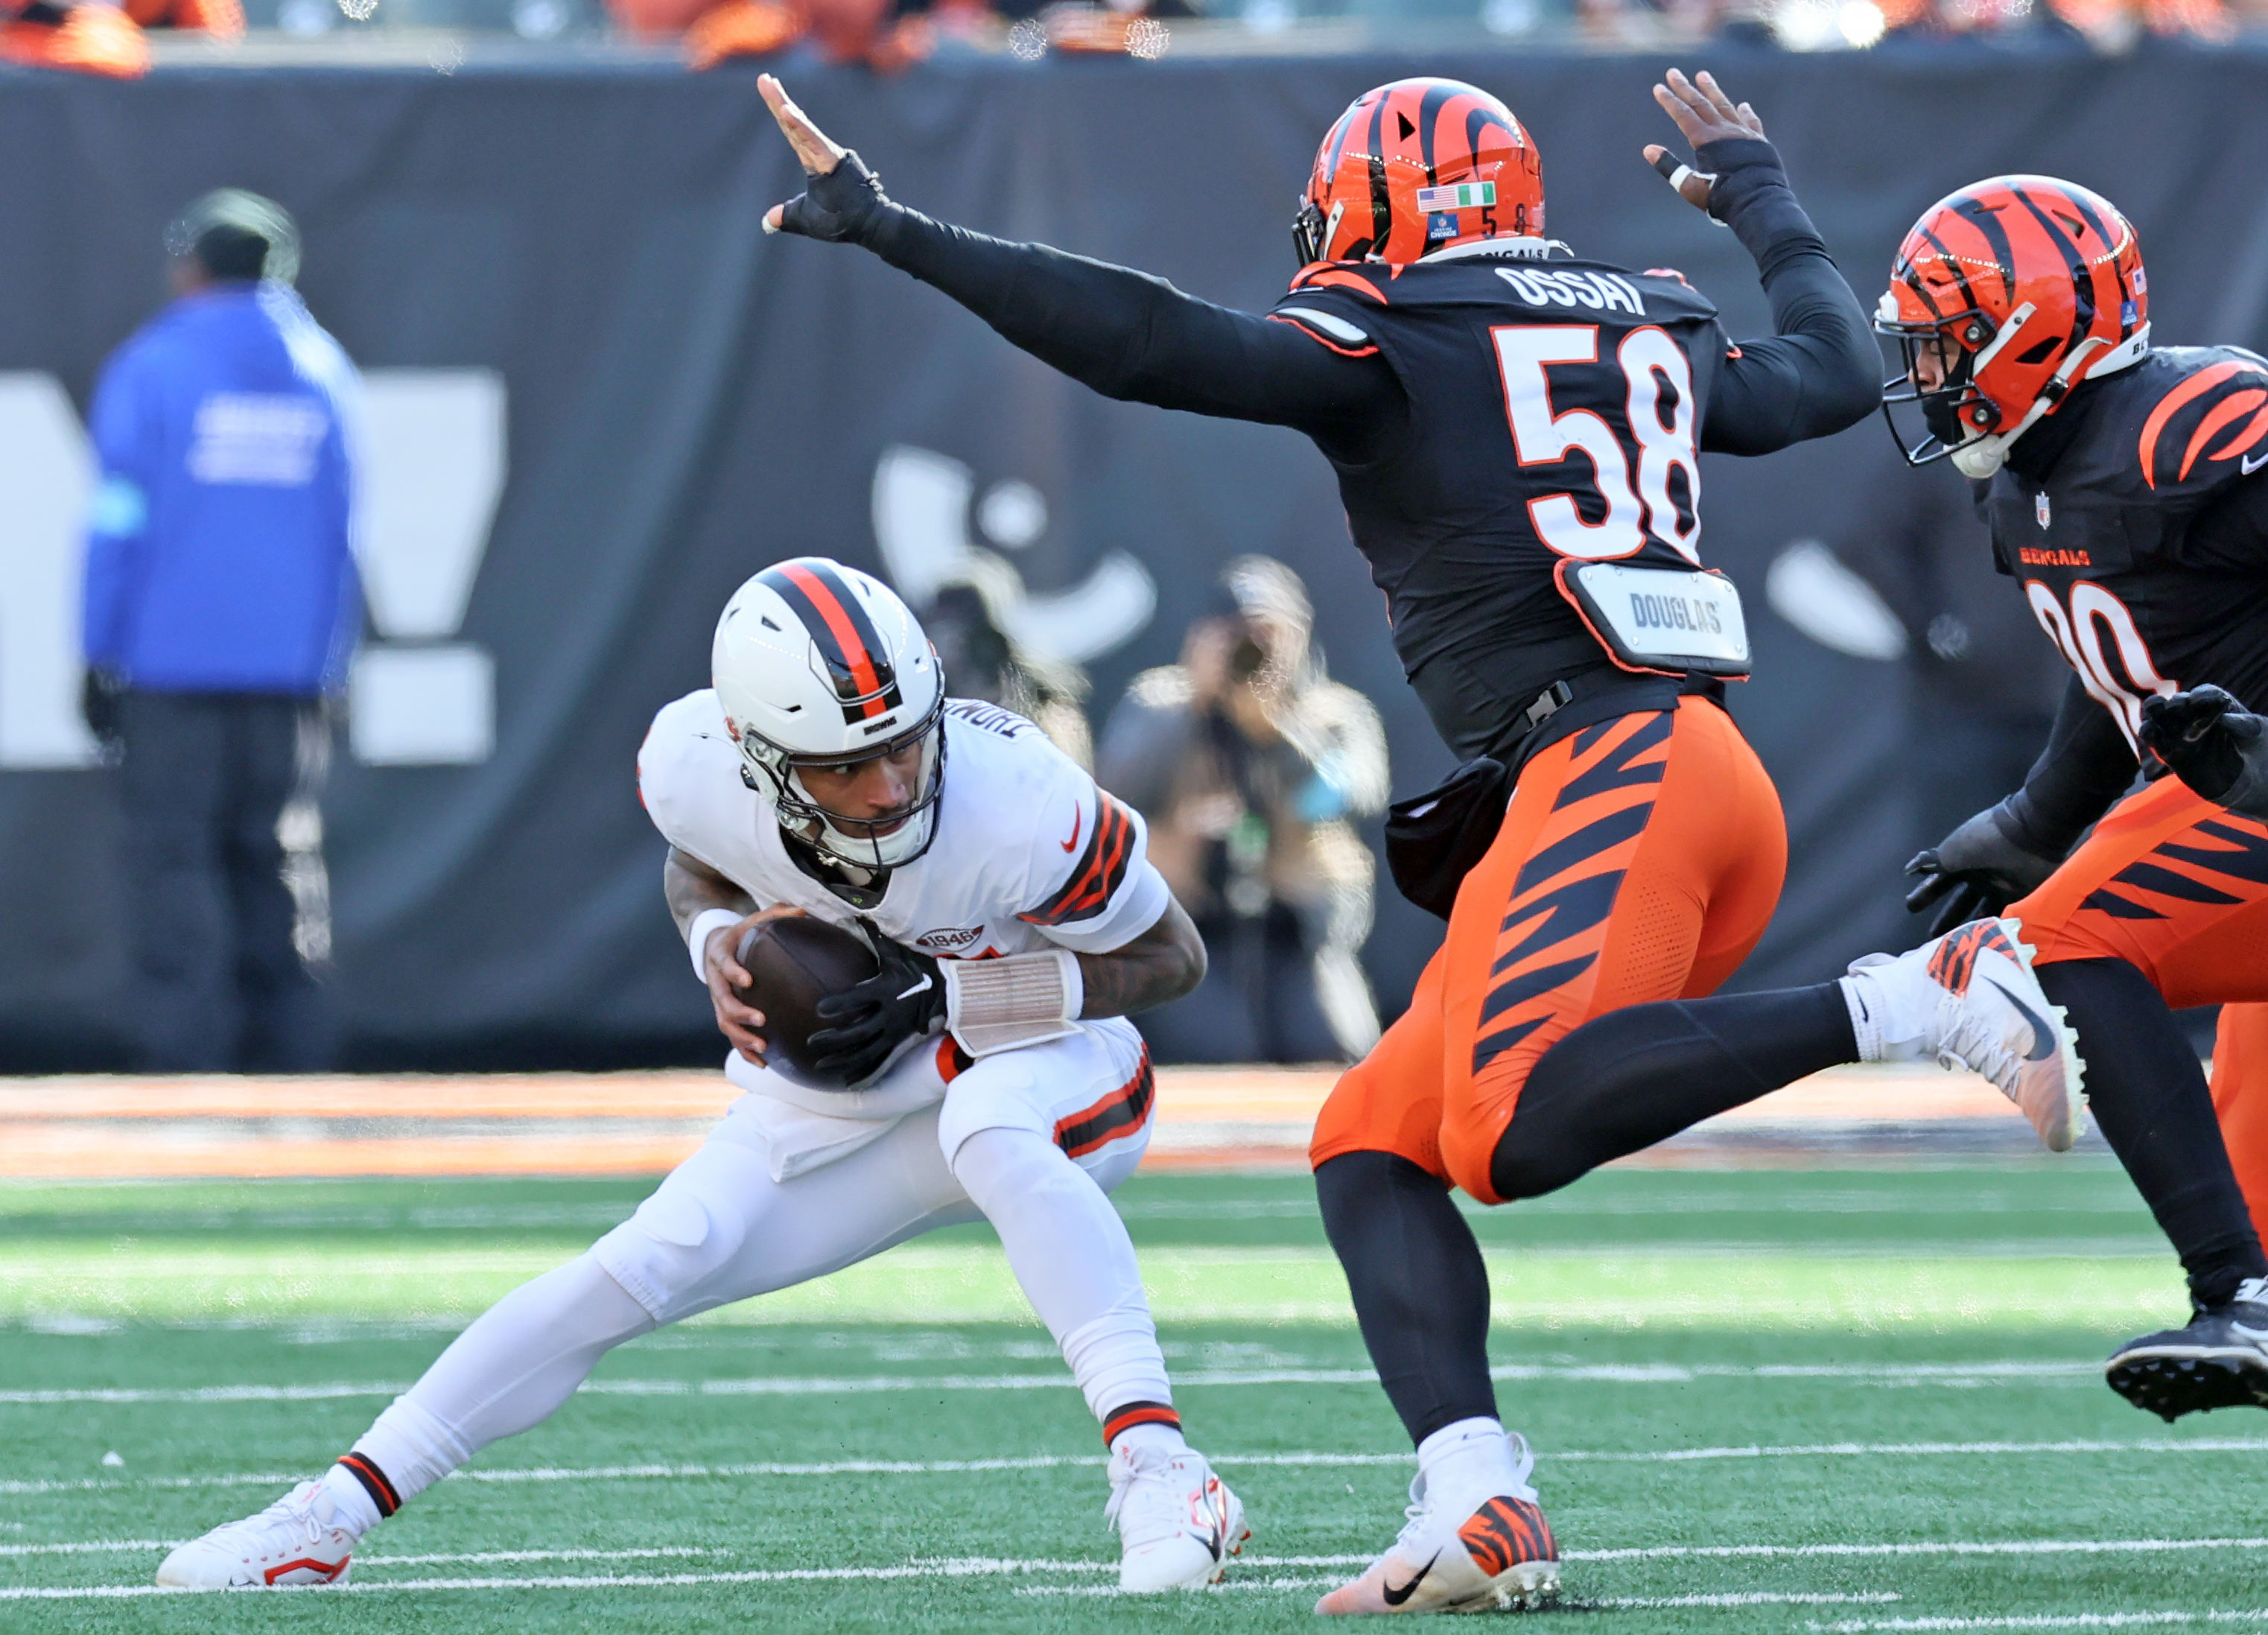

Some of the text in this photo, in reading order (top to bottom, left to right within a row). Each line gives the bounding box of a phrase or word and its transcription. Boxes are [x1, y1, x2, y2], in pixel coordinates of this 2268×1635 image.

[1494, 267, 1646, 316] OSSAI
[1489, 325, 1702, 571] 58
[2018, 547, 2091, 566] BENGALS
[1629, 593, 1722, 635] DOUGLAS
[928, 930, 974, 947] 1946
